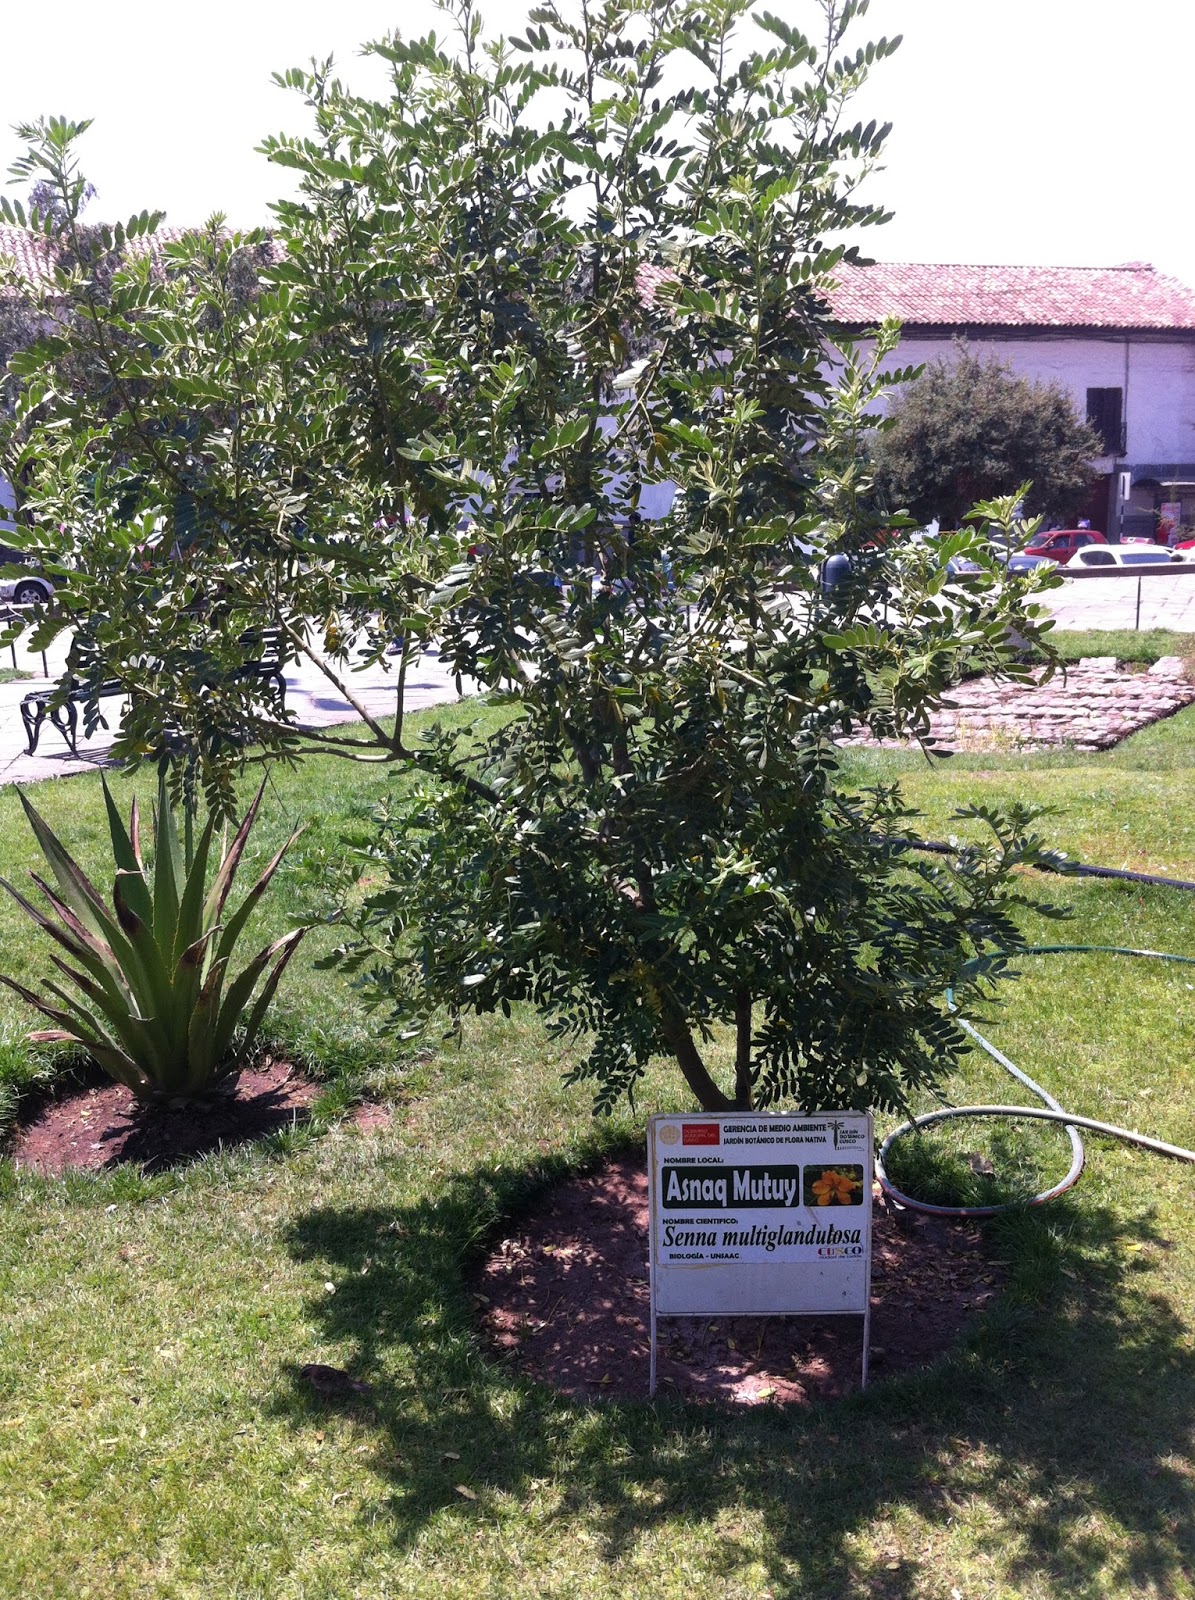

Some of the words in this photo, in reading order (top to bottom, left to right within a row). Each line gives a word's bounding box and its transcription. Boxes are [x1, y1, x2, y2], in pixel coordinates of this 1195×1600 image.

[723, 1125, 757, 1133] GERENCIA
[758, 1125, 768, 1133] DE
[769, 1124, 791, 1132] MEDIO
[792, 1123, 827, 1132] AMBIENTE
[723, 1136, 744, 1145] JARDÍN
[745, 1134, 775, 1144] BOTÁNICO
[775, 1136, 784, 1144] DE
[666, 1170, 727, 1207] Asnaq
[733, 1169, 796, 1207] Mutuy
[662, 1225, 717, 1247] Senna
[722, 1223, 861, 1252] multiglandulosa
[817, 1246, 862, 1256] CUSCO
